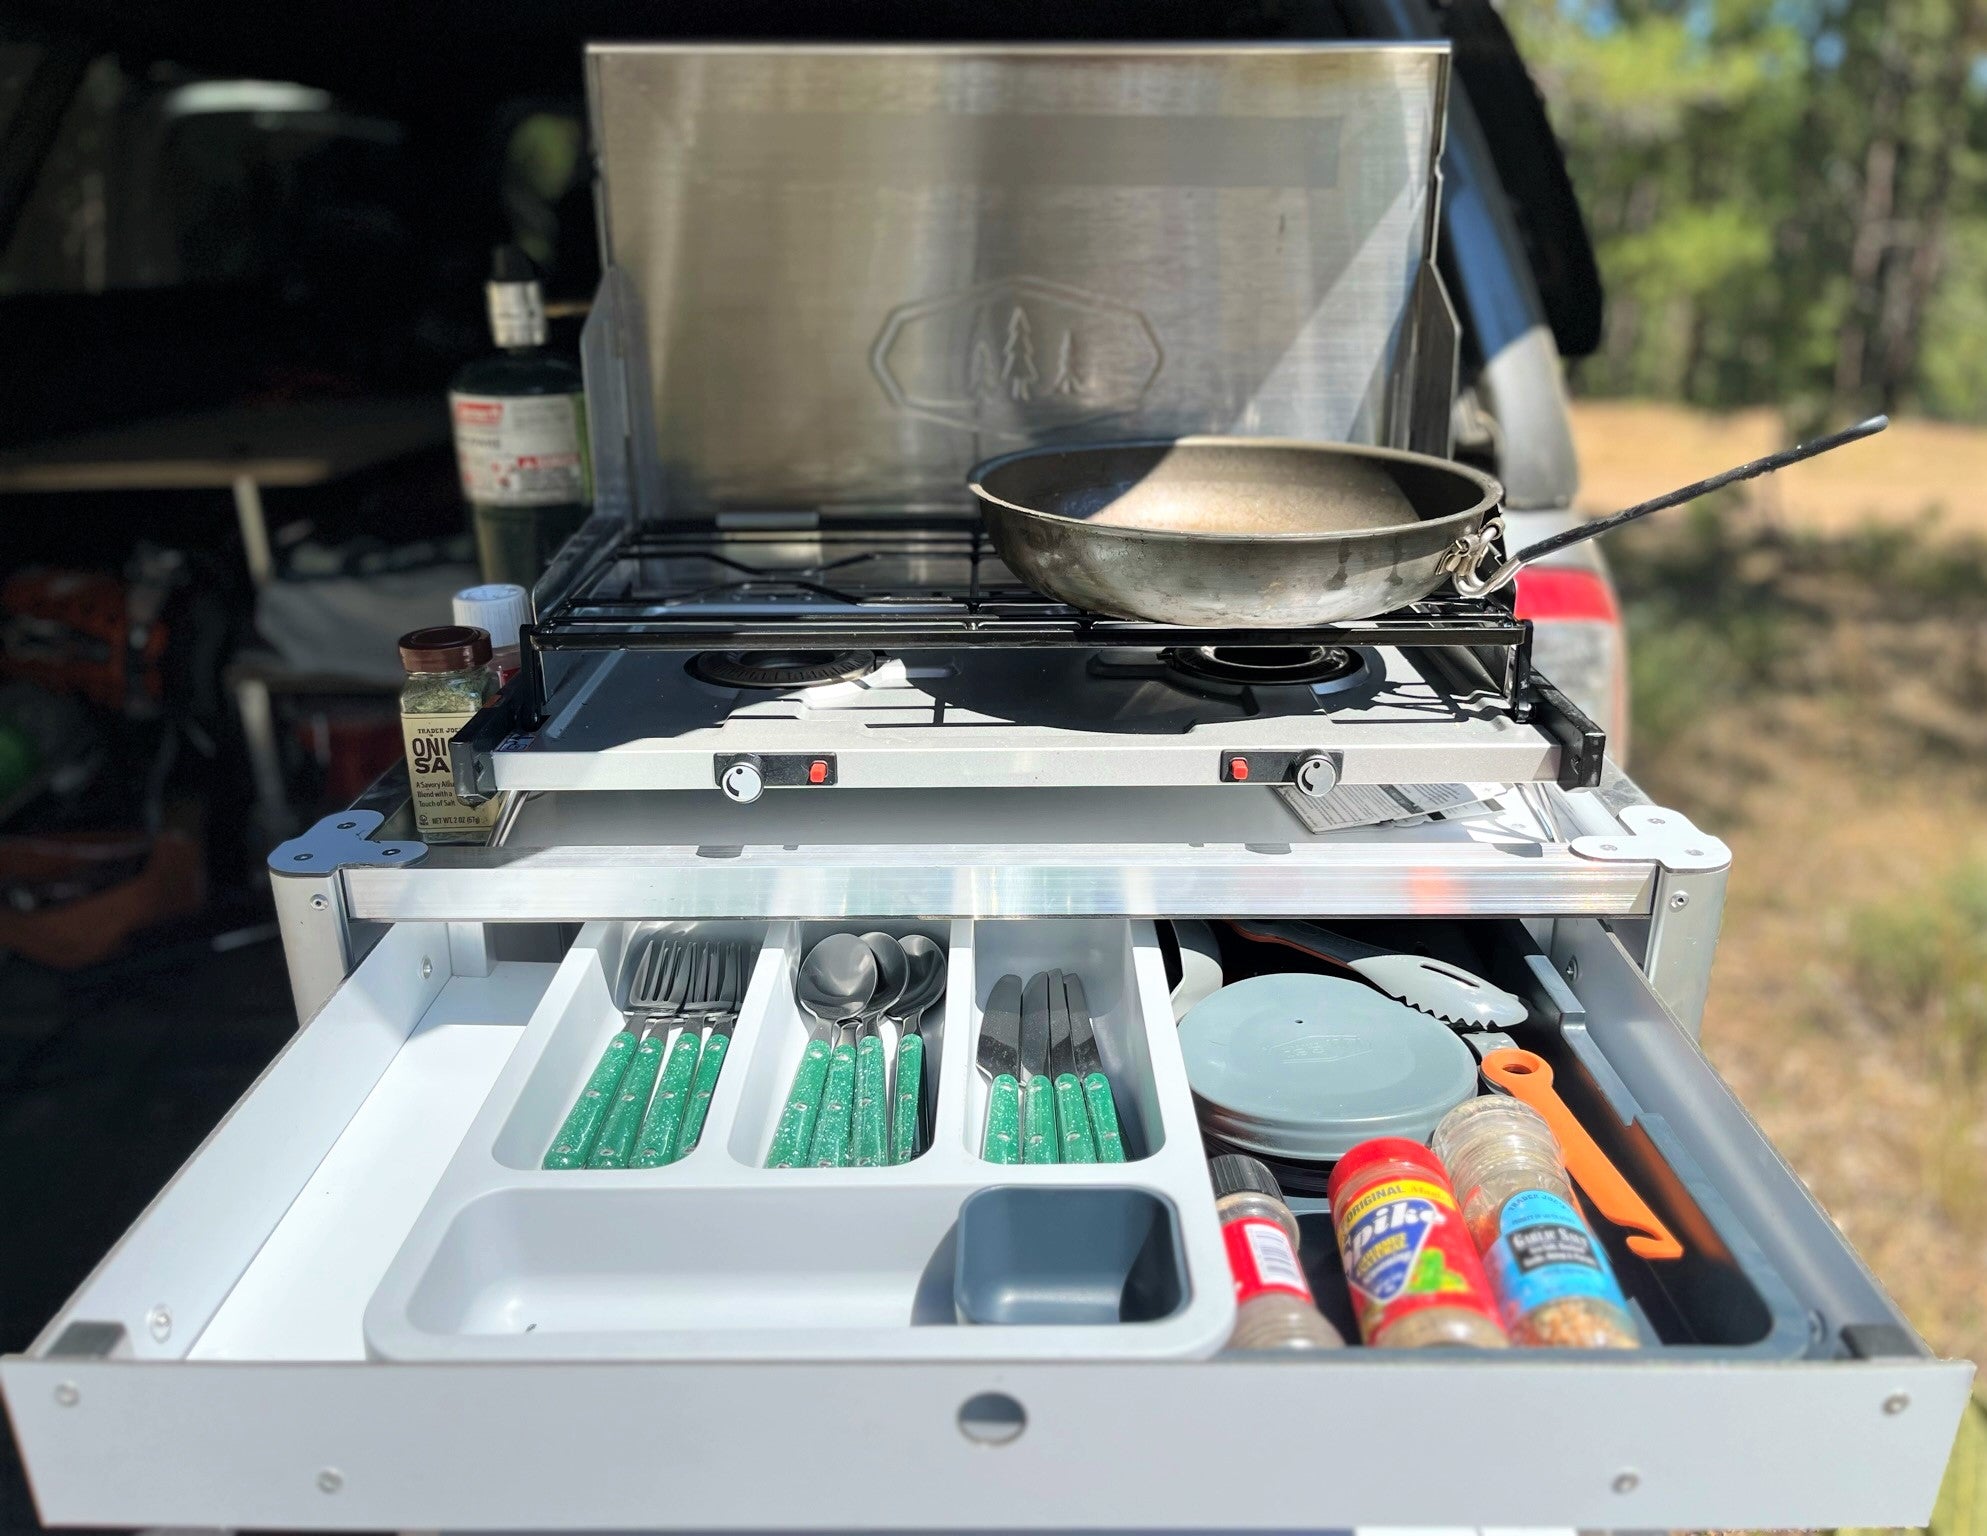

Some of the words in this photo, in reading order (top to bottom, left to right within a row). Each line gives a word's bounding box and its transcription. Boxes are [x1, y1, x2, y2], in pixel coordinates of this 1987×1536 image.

[412, 737, 452, 760] ONI
[414, 757, 451, 774] SA
[421, 781, 441, 790] Savory
[435, 790, 448, 798] with
[419, 800, 436, 808] Touch
[443, 799, 457, 807] Salt
[432, 817, 442, 825] NET
[1345, 1184, 1406, 1223] ORIGINAL
